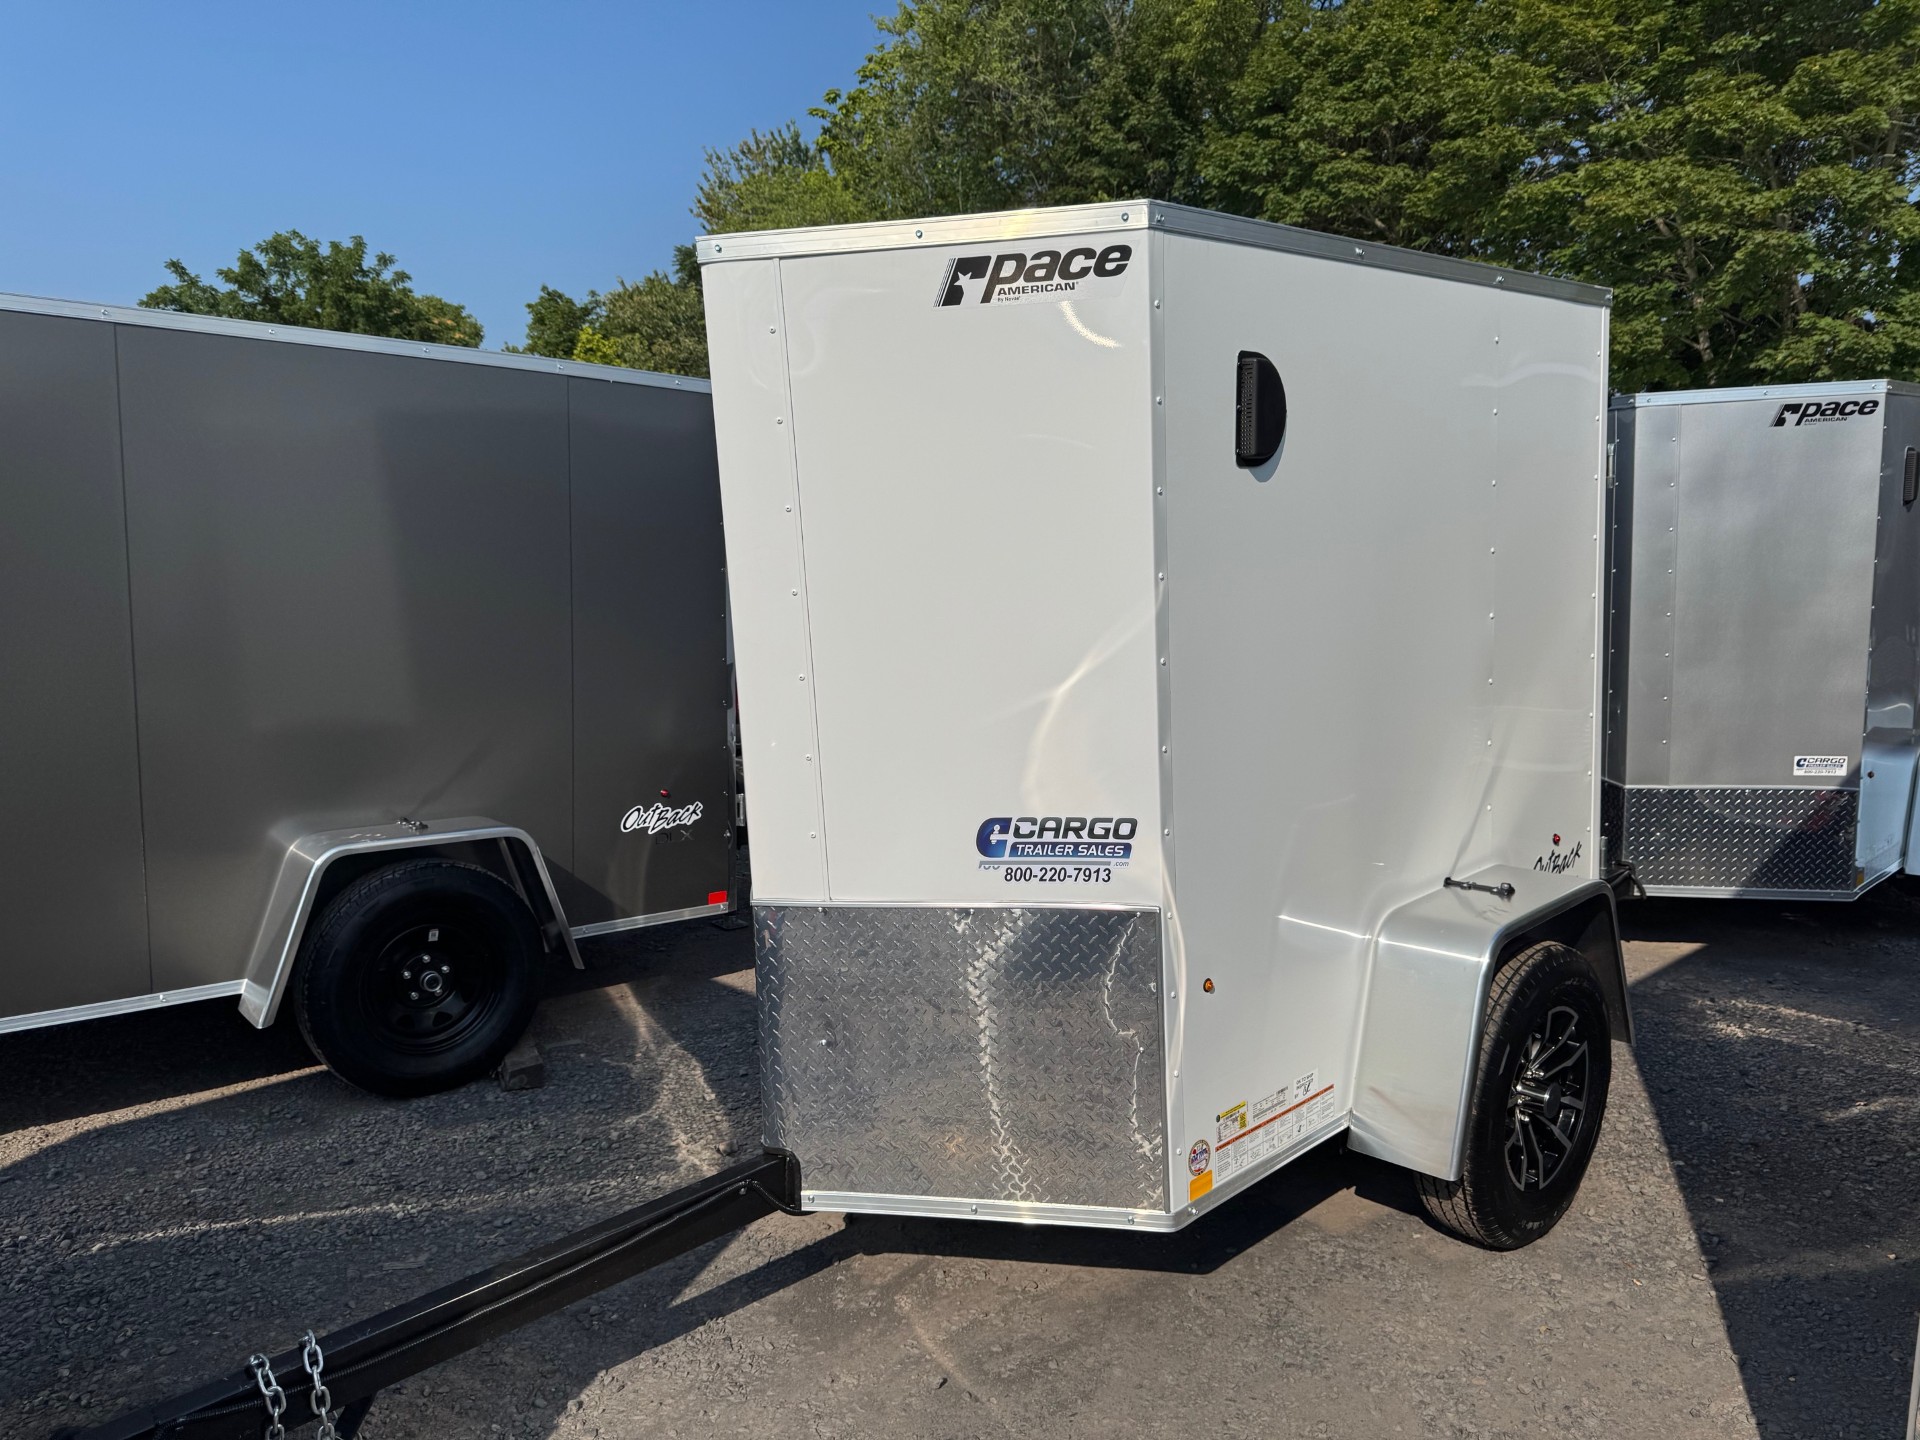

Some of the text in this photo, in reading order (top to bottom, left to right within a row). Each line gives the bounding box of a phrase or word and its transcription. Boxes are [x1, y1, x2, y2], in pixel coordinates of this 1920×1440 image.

[980, 245, 1132, 304] pace
[997, 282, 1076, 296] AMERICAN
[1794, 400, 1880, 426] pace
[1012, 816, 1138, 840] CARGO
[1016, 844, 1125, 857] TRAILER SALES
[1004, 867, 1112, 883] 800-220-7913
